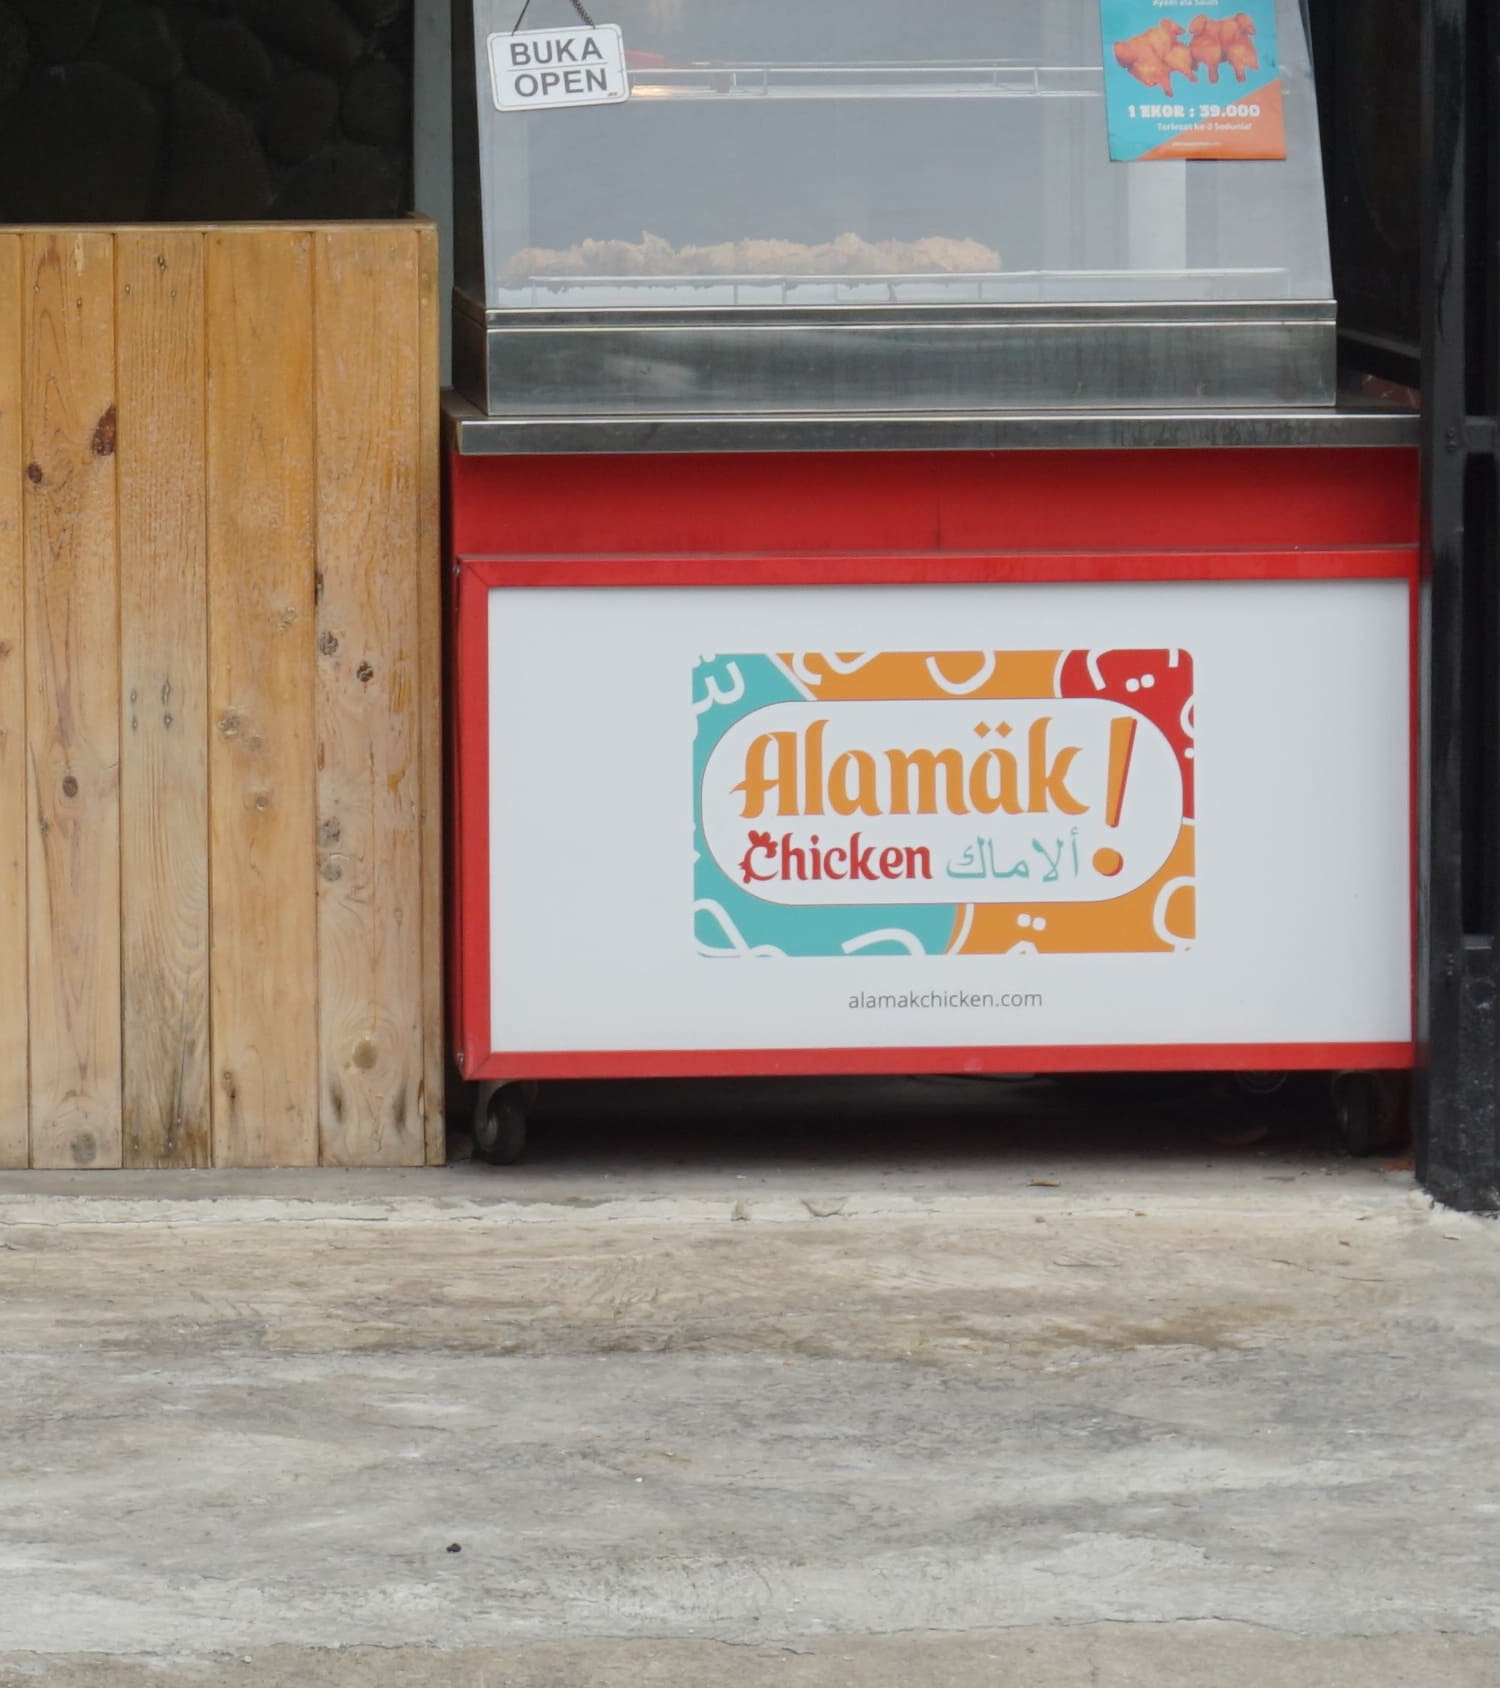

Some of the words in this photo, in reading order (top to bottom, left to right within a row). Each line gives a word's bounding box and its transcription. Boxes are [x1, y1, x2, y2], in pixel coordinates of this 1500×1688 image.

[510, 37, 603, 66] BUKA
[514, 68, 607, 97] OPEN
[1128, 105, 1136, 118] 1
[1140, 105, 1184, 118] EKOR
[738, 830, 934, 884] Chicken
[848, 990, 1043, 1010] alamakchicken.com
